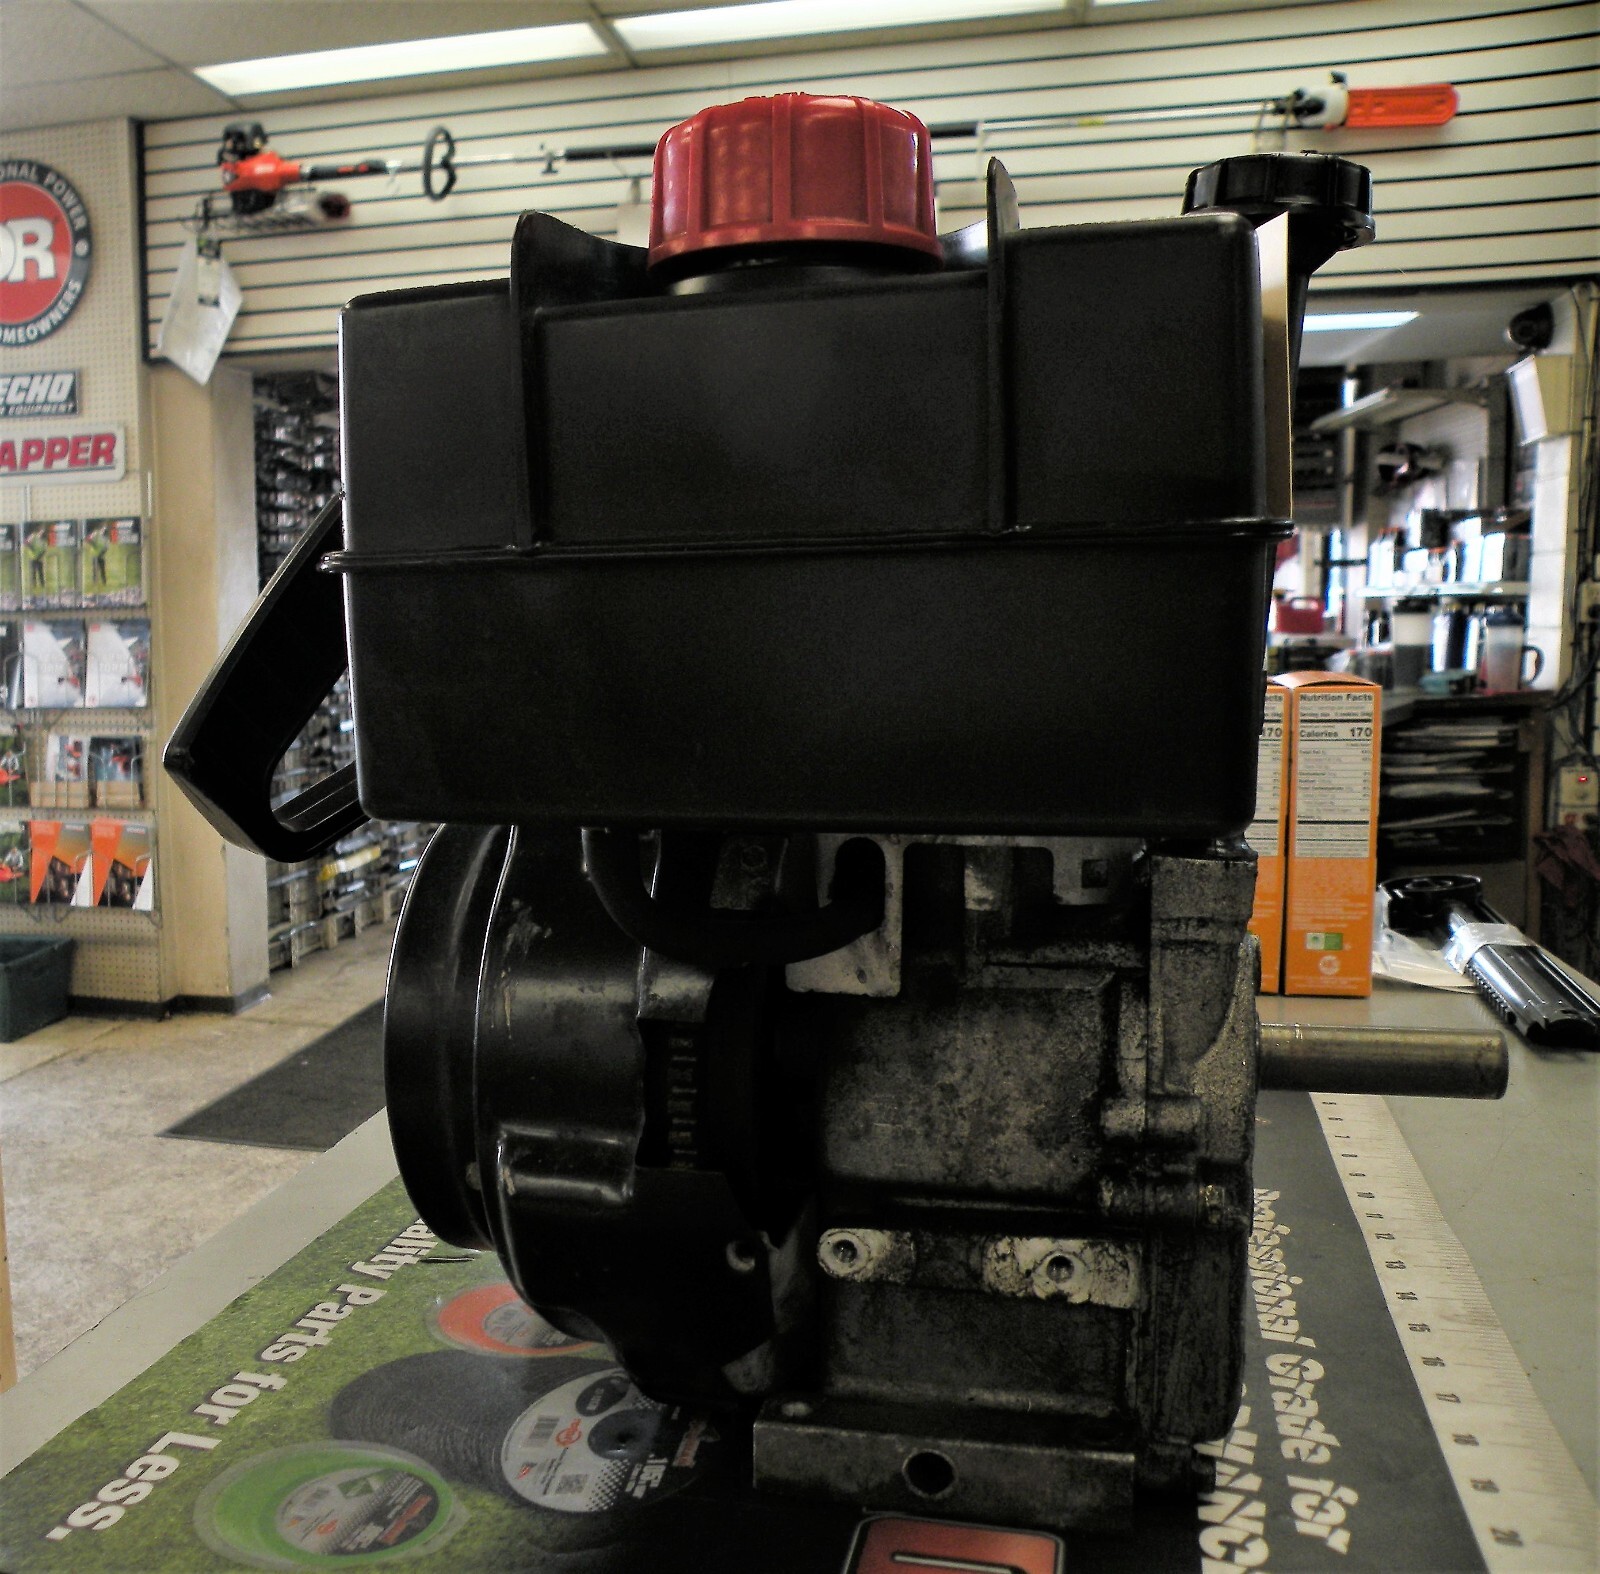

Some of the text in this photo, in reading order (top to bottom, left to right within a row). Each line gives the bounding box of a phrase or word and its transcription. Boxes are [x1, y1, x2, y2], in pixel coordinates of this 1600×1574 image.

[43, 172, 88, 231] POWER
[0, 280, 82, 344] MEOWNERS
[1300, 727, 1373, 738] Calories 170
[1356, 1191, 1376, 1199] 10
[1375, 1232, 1396, 1240] 12
[1385, 1260, 1407, 1270] 13
[1395, 1291, 1419, 1301] 14
[1407, 1323, 1431, 1333] 15
[1421, 1356, 1446, 1367] 16
[46, 1218, 438, 1541] ality Parts for Less.
[1436, 1393, 1462, 1404] 17
[1265, 1353, 1341, 1465] Grade
[1452, 1433, 1480, 1446] 18
[1470, 1478, 1500, 1493] 19
[1286, 1474, 1359, 1554] for
[1490, 1527, 1524, 1547] 20
